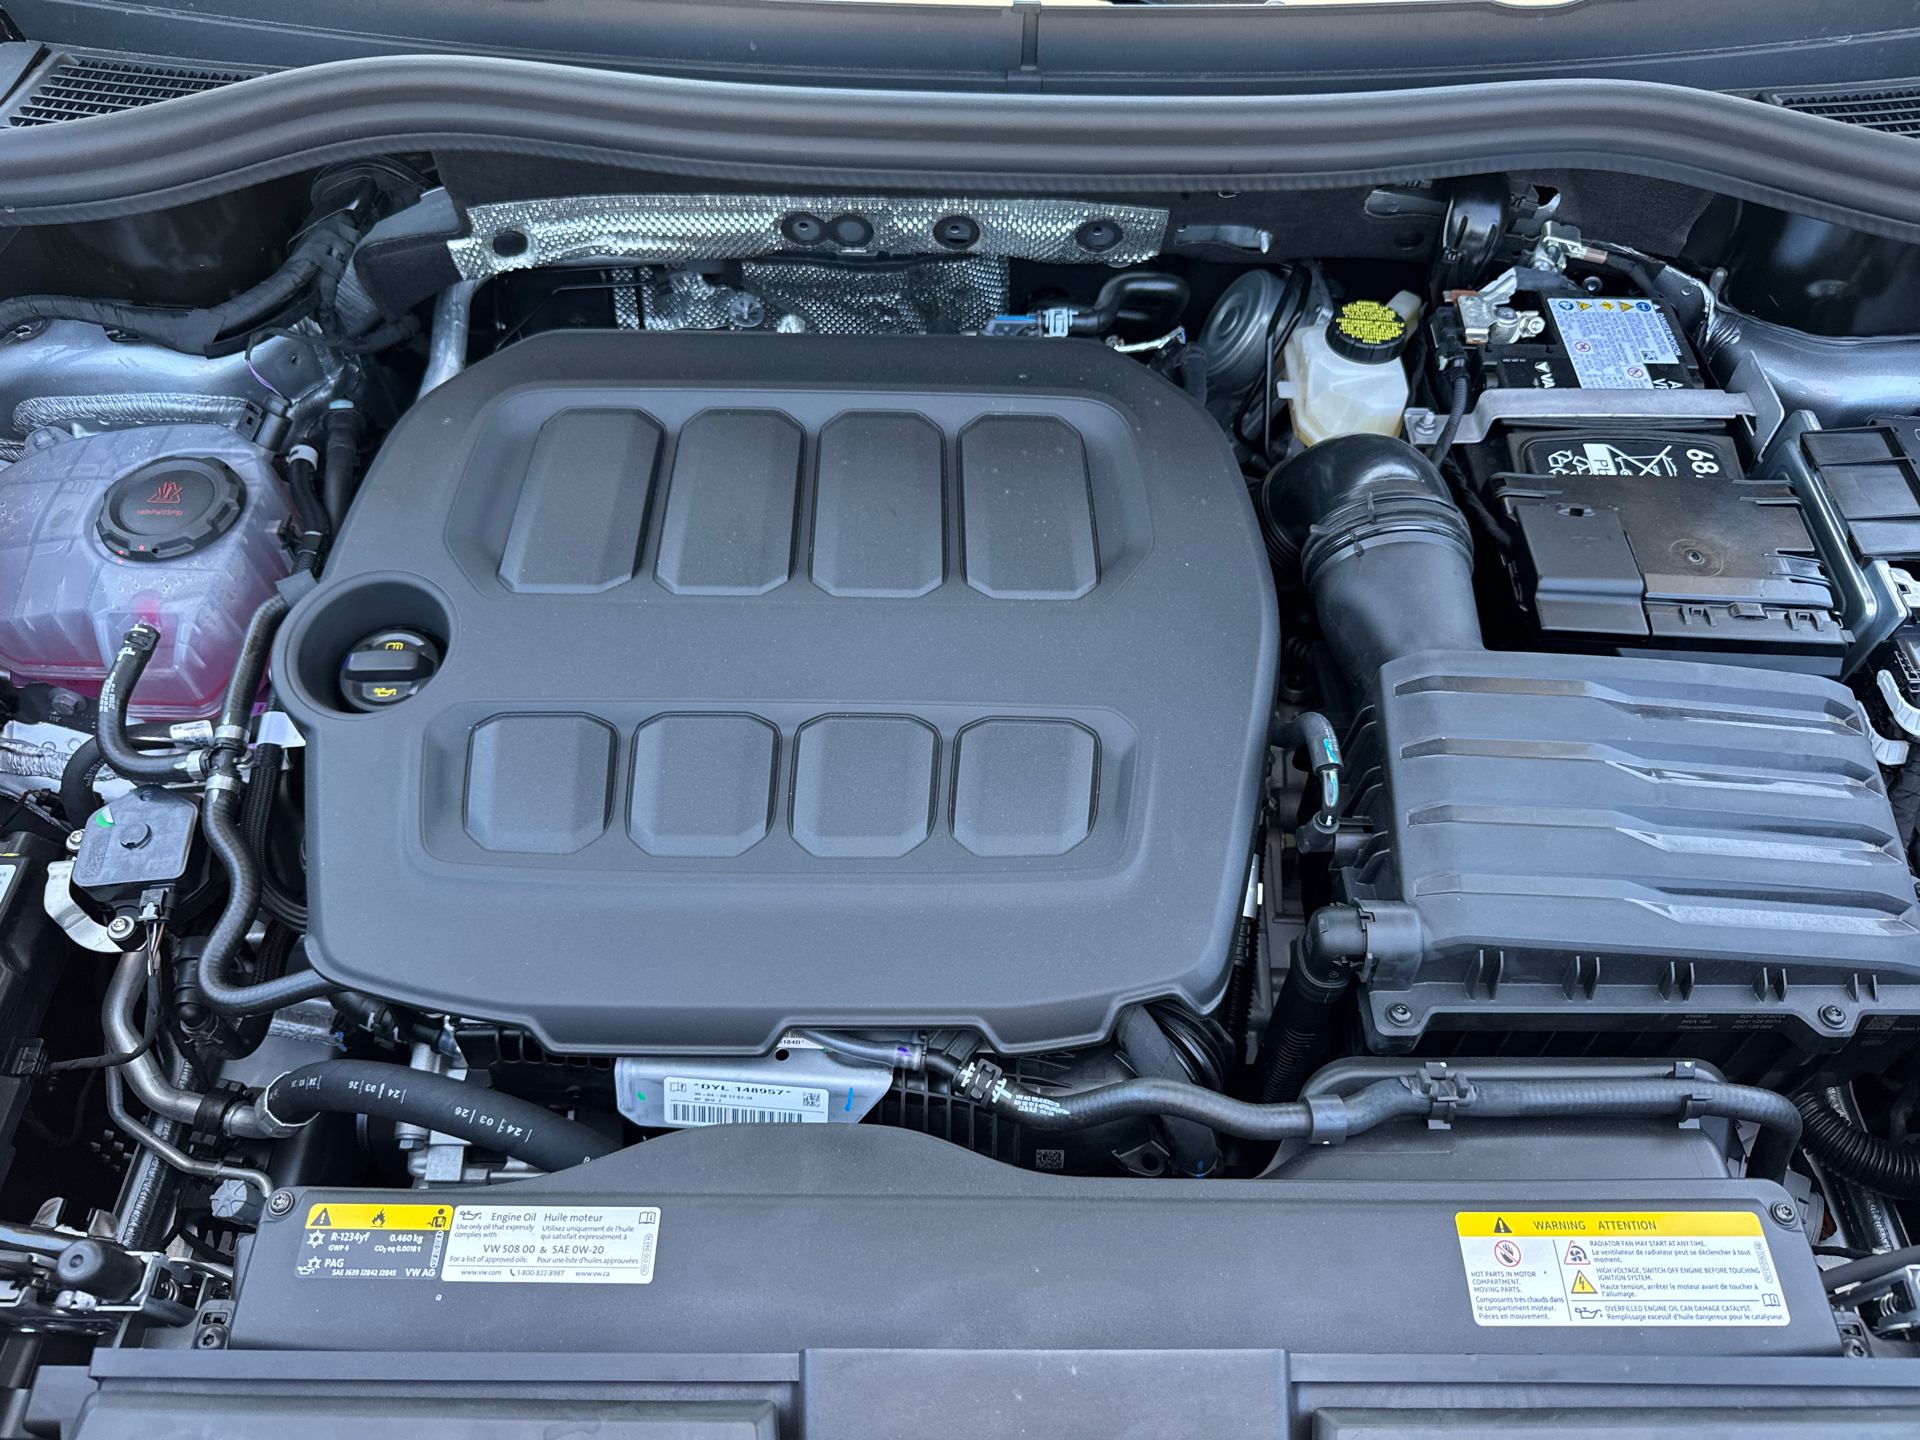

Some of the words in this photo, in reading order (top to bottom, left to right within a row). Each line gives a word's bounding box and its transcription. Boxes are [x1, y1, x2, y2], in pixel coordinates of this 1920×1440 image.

[455, 1106, 469, 1117] 26
[479, 1115, 494, 1126] 03
[507, 1125, 523, 1136] 24
[491, 1213, 521, 1223] Engine
[524, 1213, 536, 1222] Oil
[544, 1213, 568, 1222] Huile
[1533, 1221, 1586, 1230] WARNING
[1598, 1221, 1656, 1230] ATTENTION
[331, 1232, 370, 1244] R-1234yf
[413, 1235, 423, 1244] kg
[483, 1245, 500, 1253] VW
[502, 1245, 520, 1253] 508
[522, 1245, 536, 1253] 00
[552, 1245, 570, 1254] SAE
[572, 1245, 605, 1254] 0W-20
[324, 1259, 344, 1268] PAG
